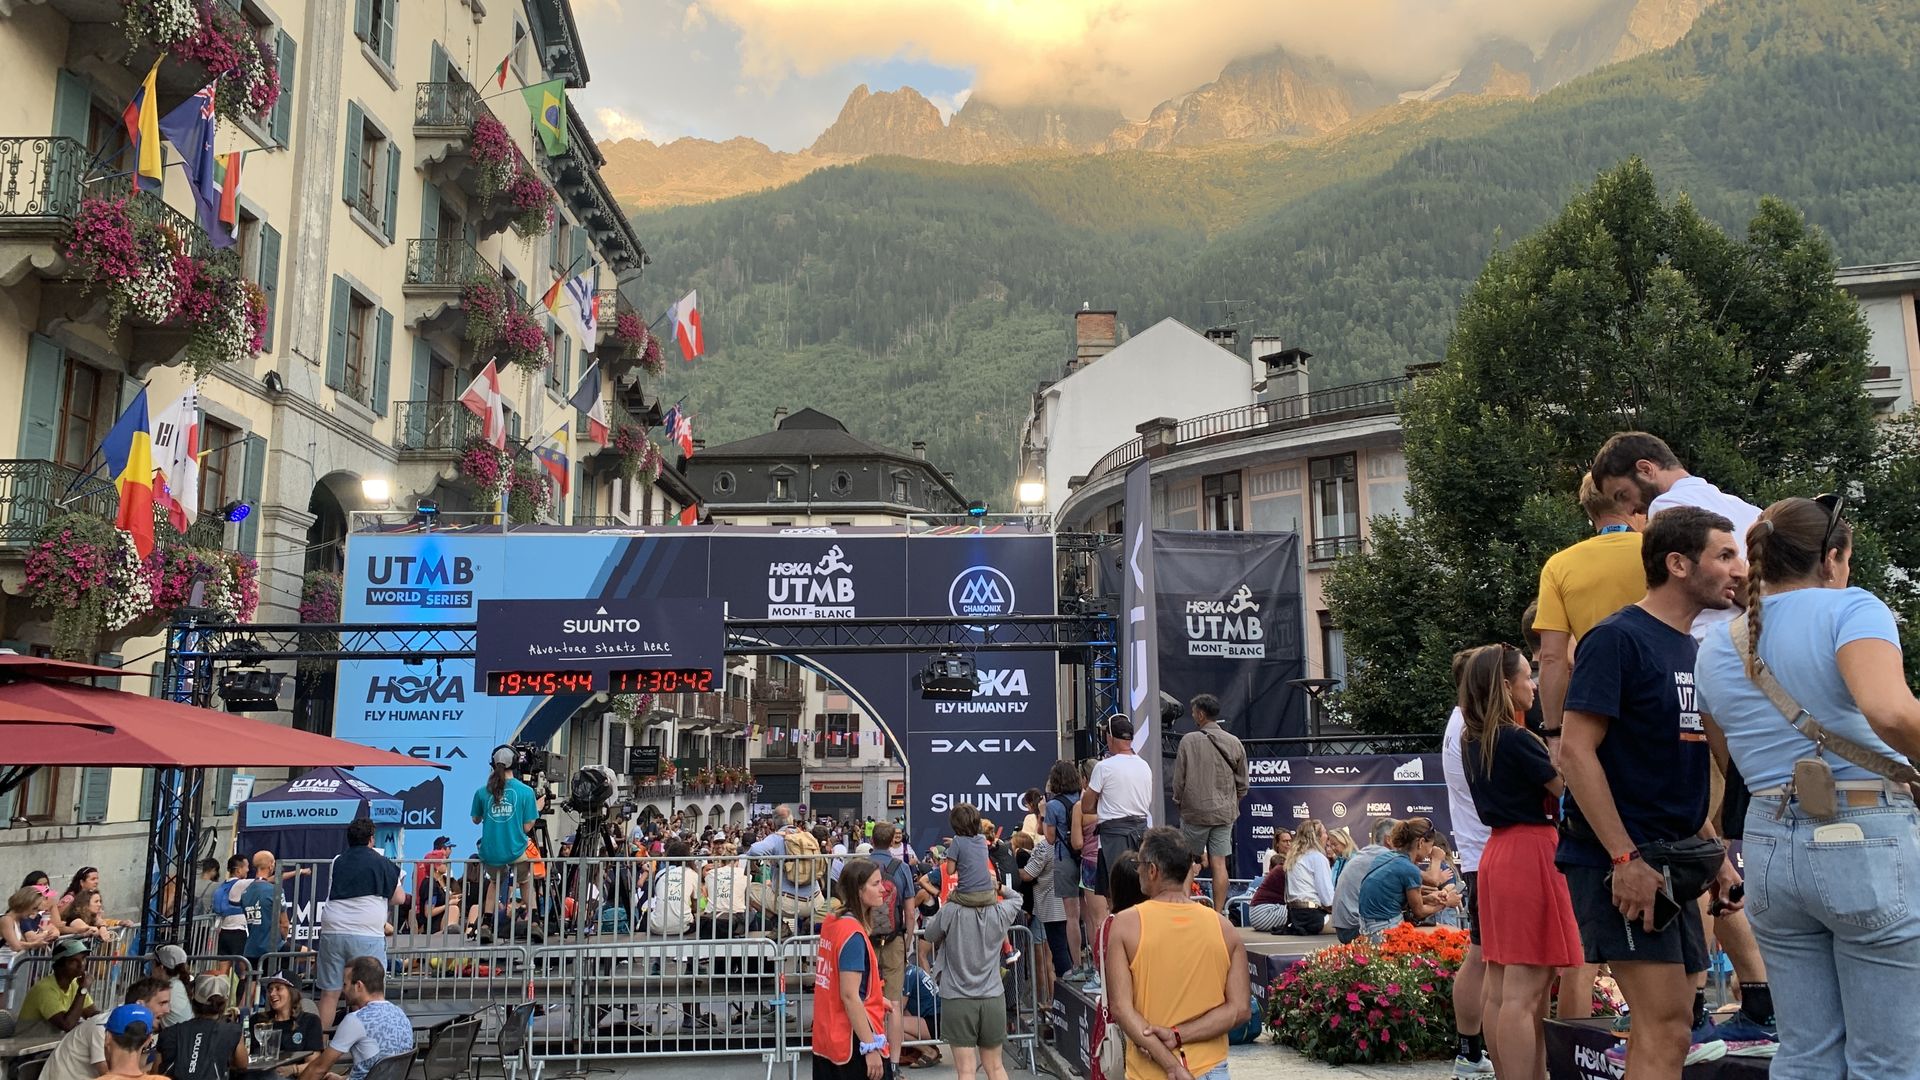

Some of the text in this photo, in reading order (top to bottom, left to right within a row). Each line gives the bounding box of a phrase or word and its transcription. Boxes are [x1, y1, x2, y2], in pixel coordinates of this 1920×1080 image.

[367, 555, 474, 585] UTMB
[769, 562, 812, 576] HOKA
[768, 576, 855, 604] UTMB
[370, 591, 469, 605] WORLD SERIES
[963, 604, 1002, 613] CHAMONIX
[1186, 601, 1225, 614] HOKA
[563, 619, 641, 633] SUUNTO
[1186, 615, 1264, 641] UTMB
[499, 671, 713, 695] 19:45:44 11:30:42
[1674, 671, 1695, 685] HOKA
[366, 675, 465, 703] HOKA
[935, 701, 1028, 714] FLY HUMAN FLY
[365, 709, 463, 721] FLY HUMAN FLY
[931, 739, 1036, 753] DACIA
[1249, 760, 1291, 775] HOKA
[1314, 766, 1361, 774] DACIA
[291, 778, 340, 788] UTMB
[261, 808, 338, 819] UTMB.WORLD
[1251, 803, 1273, 812] UTMB
[1367, 802, 1392, 812] HOKA
[1252, 825, 1275, 835] HOKA
[188, 1032, 203, 1074] salomon
